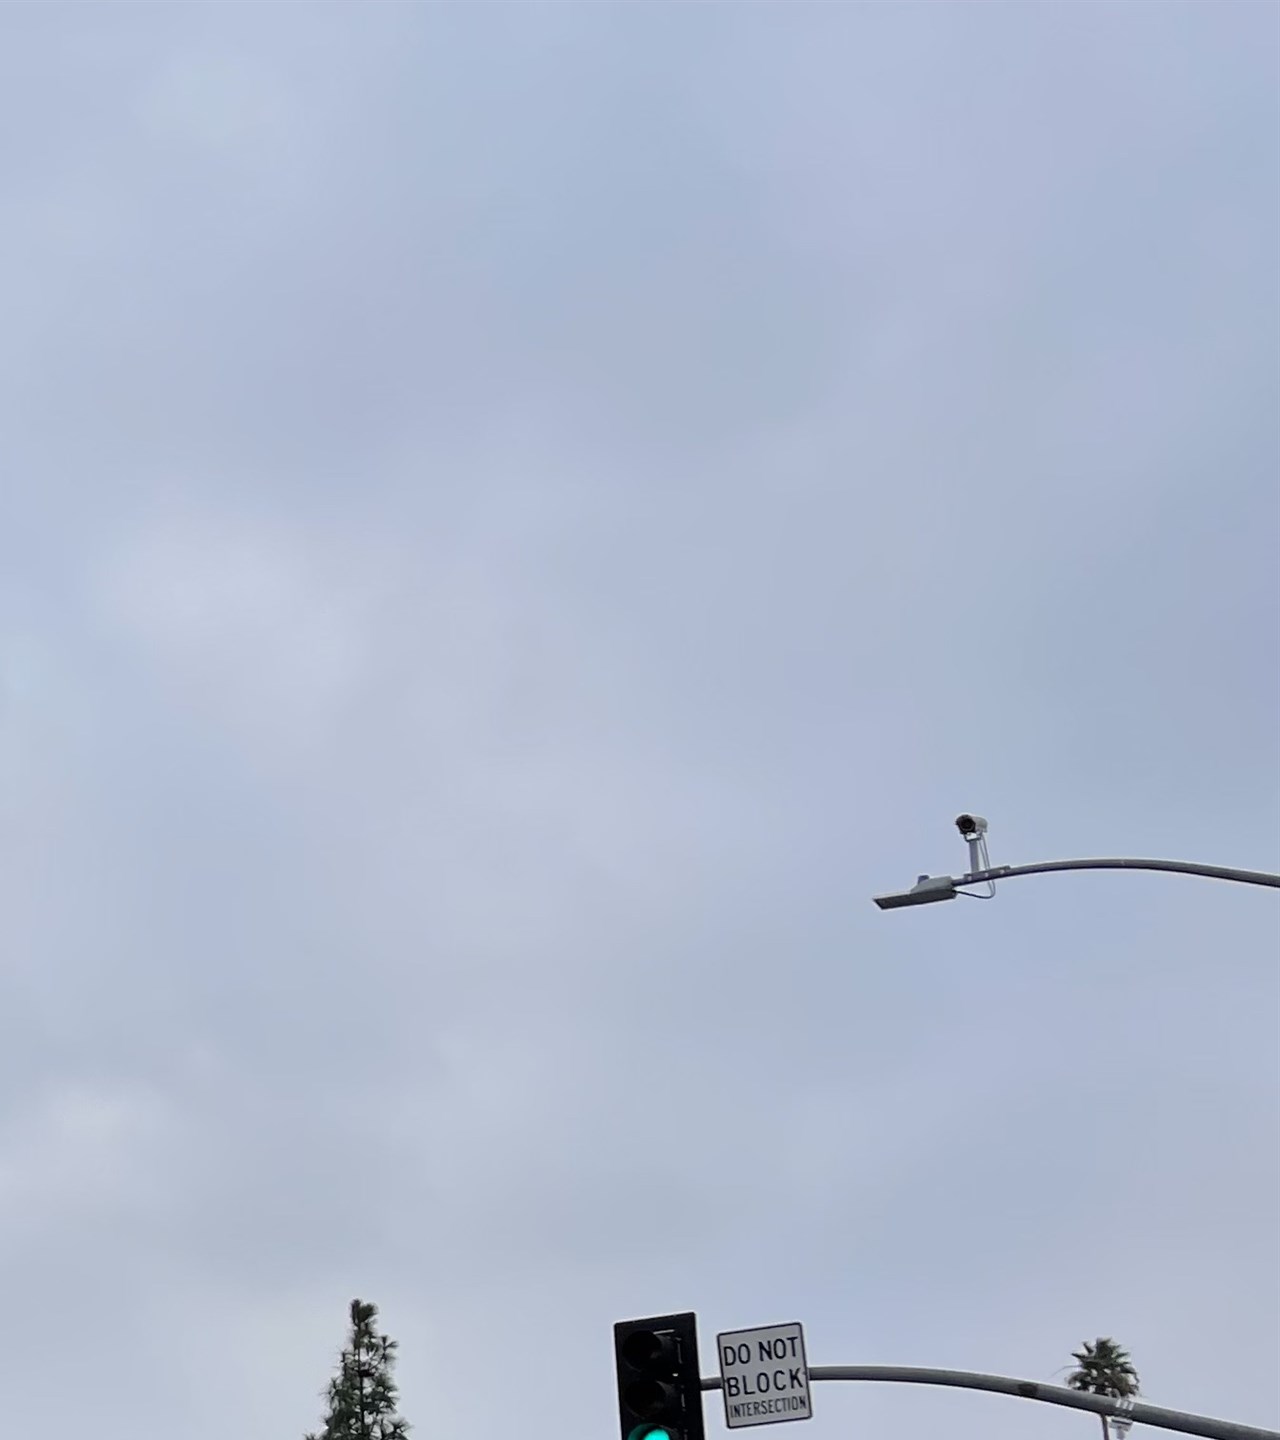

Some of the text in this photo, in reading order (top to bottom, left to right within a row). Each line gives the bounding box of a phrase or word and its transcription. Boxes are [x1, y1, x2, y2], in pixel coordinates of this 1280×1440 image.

[723, 1336, 798, 1366] DO NOT
[726, 1367, 804, 1397] BLOCK
[730, 1396, 807, 1418] INTERSECTION
